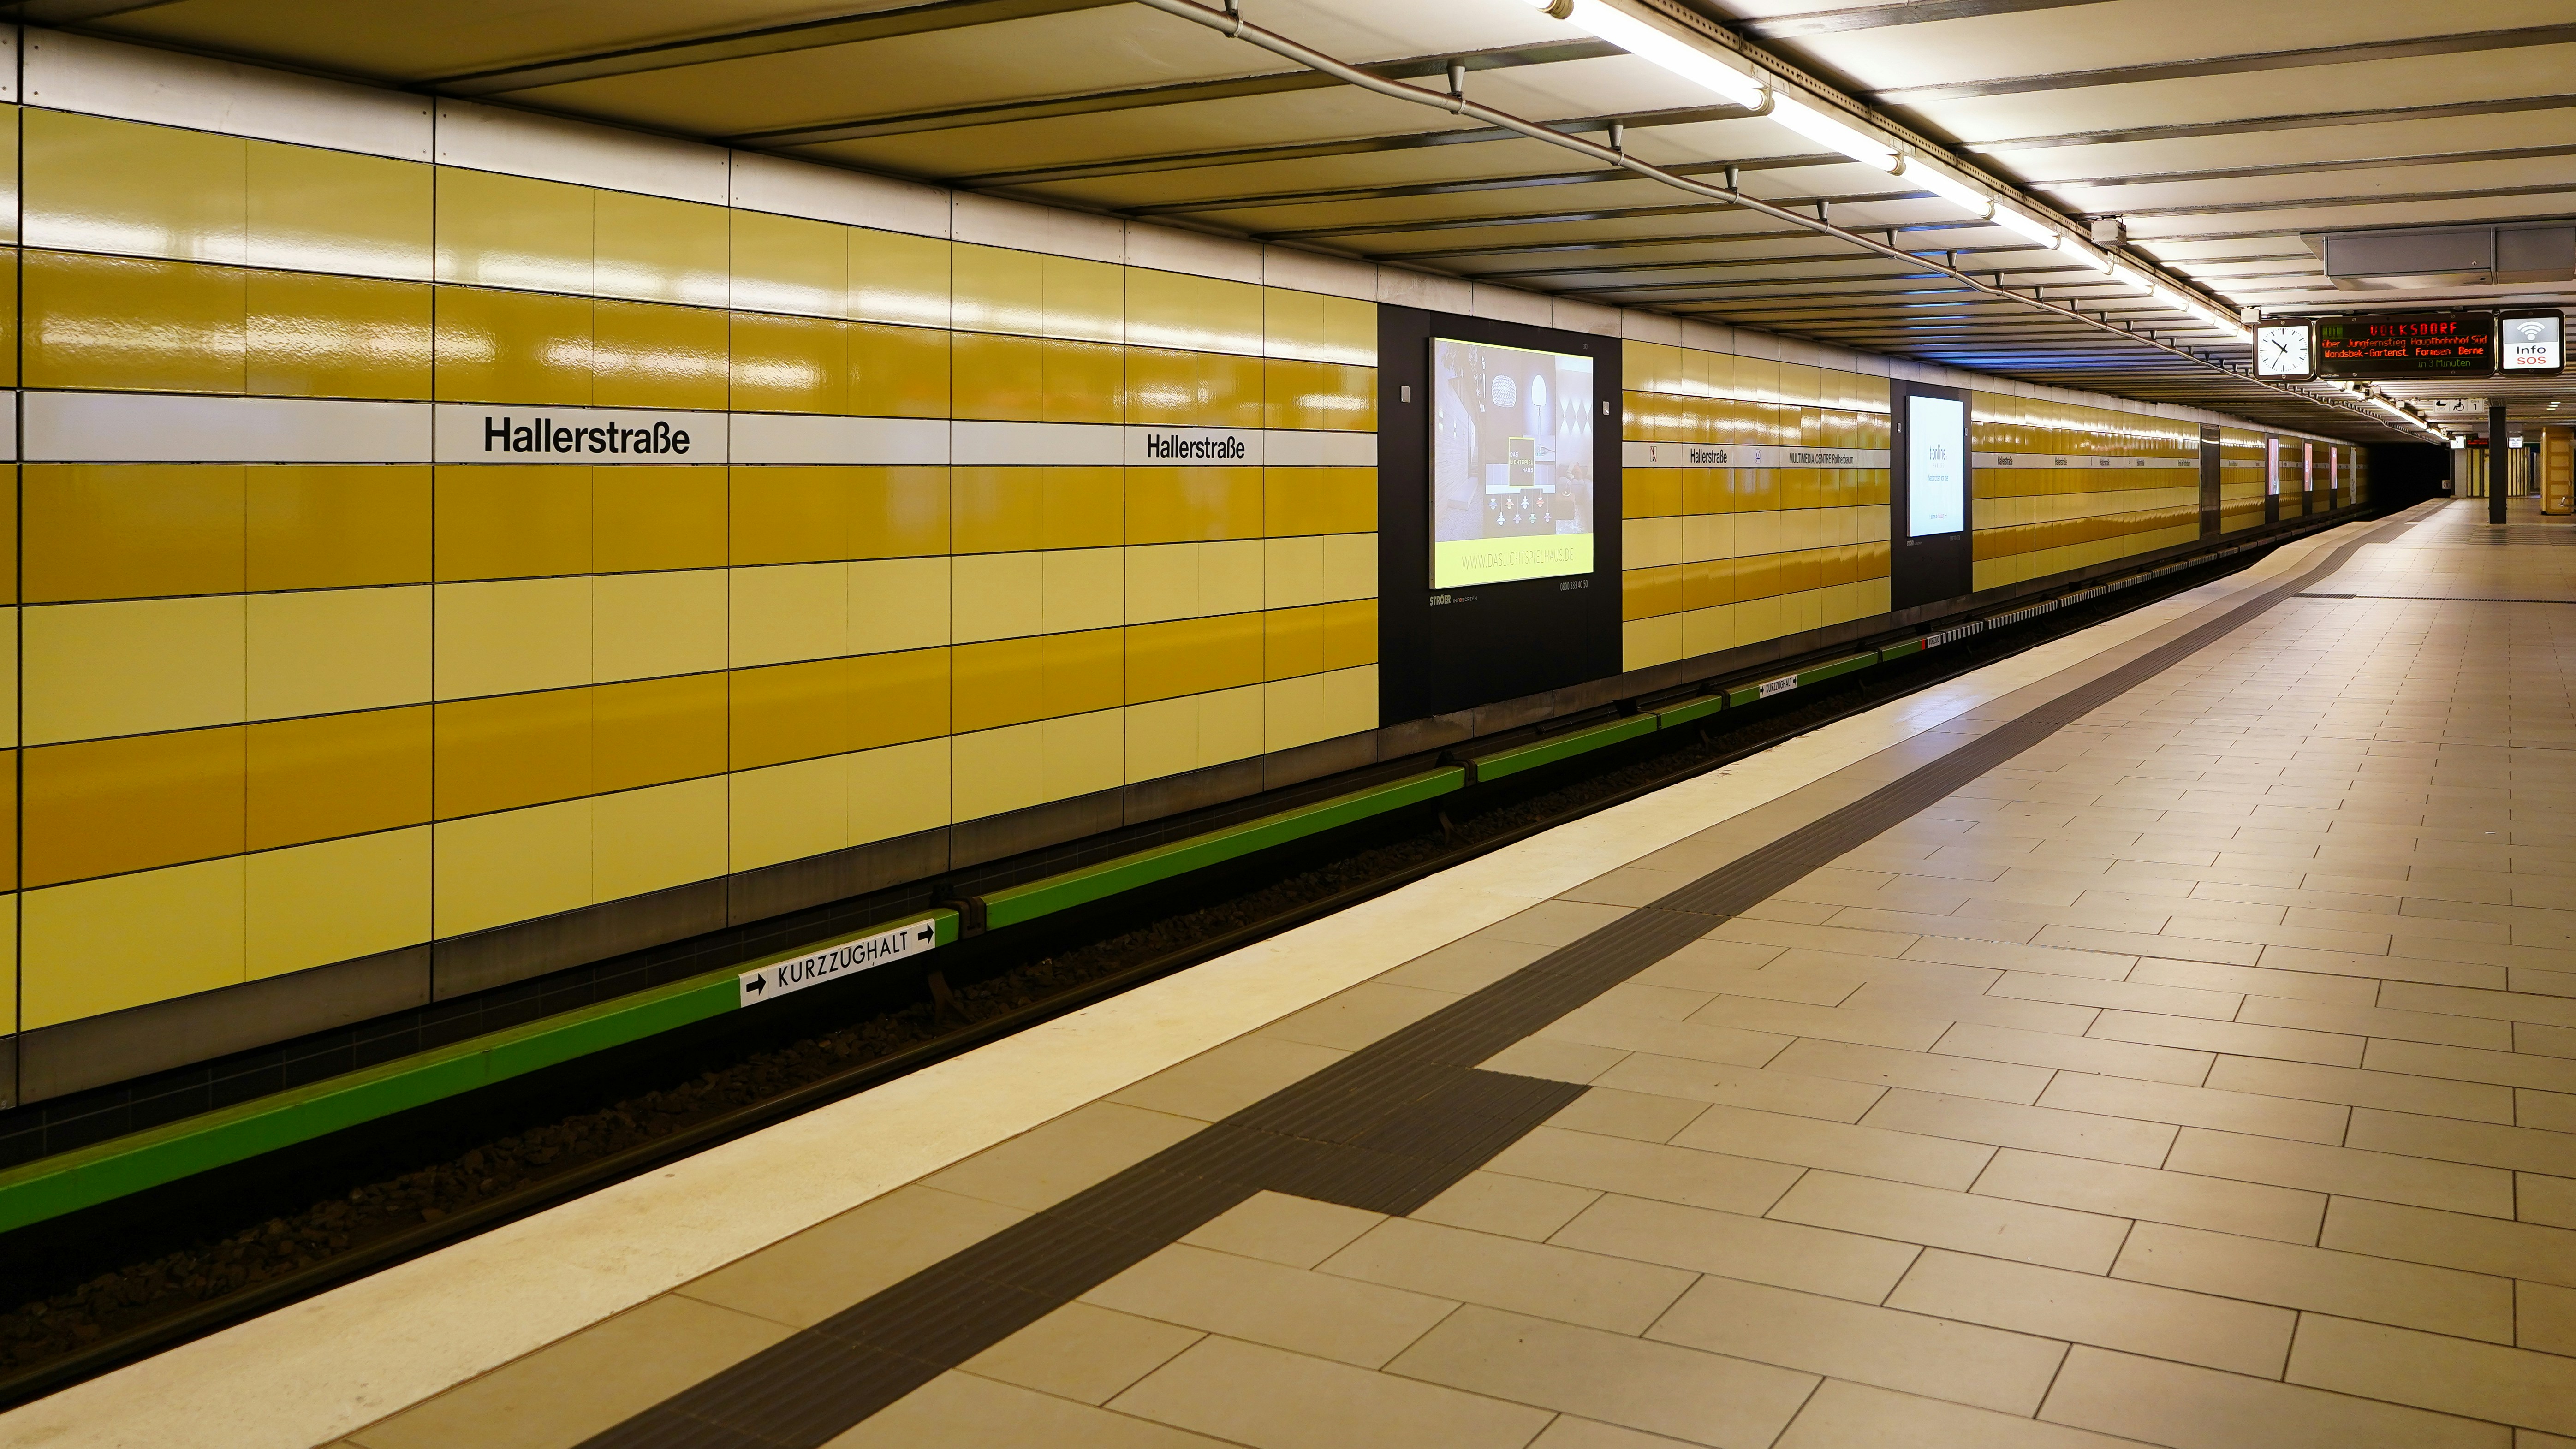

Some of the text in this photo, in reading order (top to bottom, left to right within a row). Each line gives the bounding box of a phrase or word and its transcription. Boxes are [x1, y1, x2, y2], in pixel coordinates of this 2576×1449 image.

[2327, 326, 2338, 338] U1
[2370, 322, 2457, 336] VOLKSDORF
[2322, 335, 2487, 349] über Jungfernstieg Hauptbahnhof Süd
[2416, 347, 2451, 356] Farmsen
[2458, 346, 2484, 355] Berne
[2517, 345, 2546, 354] Info
[2436, 359, 2470, 368] Minuten
[2517, 356, 2546, 365] SOS
[485, 416, 690, 454] Hallerstraße
[1148, 434, 1245, 459] Hallerstraße
[1690, 448, 1727, 464] Hallerstraße
[1789, 453, 1854, 464] MULTIMEDIA CENTRE Rotherbaum
[1462, 548, 1574, 570] WWW.DASLICHTSPIELHAUS.DE
[1560, 582, 1570, 591] 0800
[1583, 579, 1588, 588] 50
[1430, 594, 1451, 606] STRÖER
[1766, 677, 1792, 693] KURZZUGHALT
[779, 932, 907, 987] KURZZUGHALT
